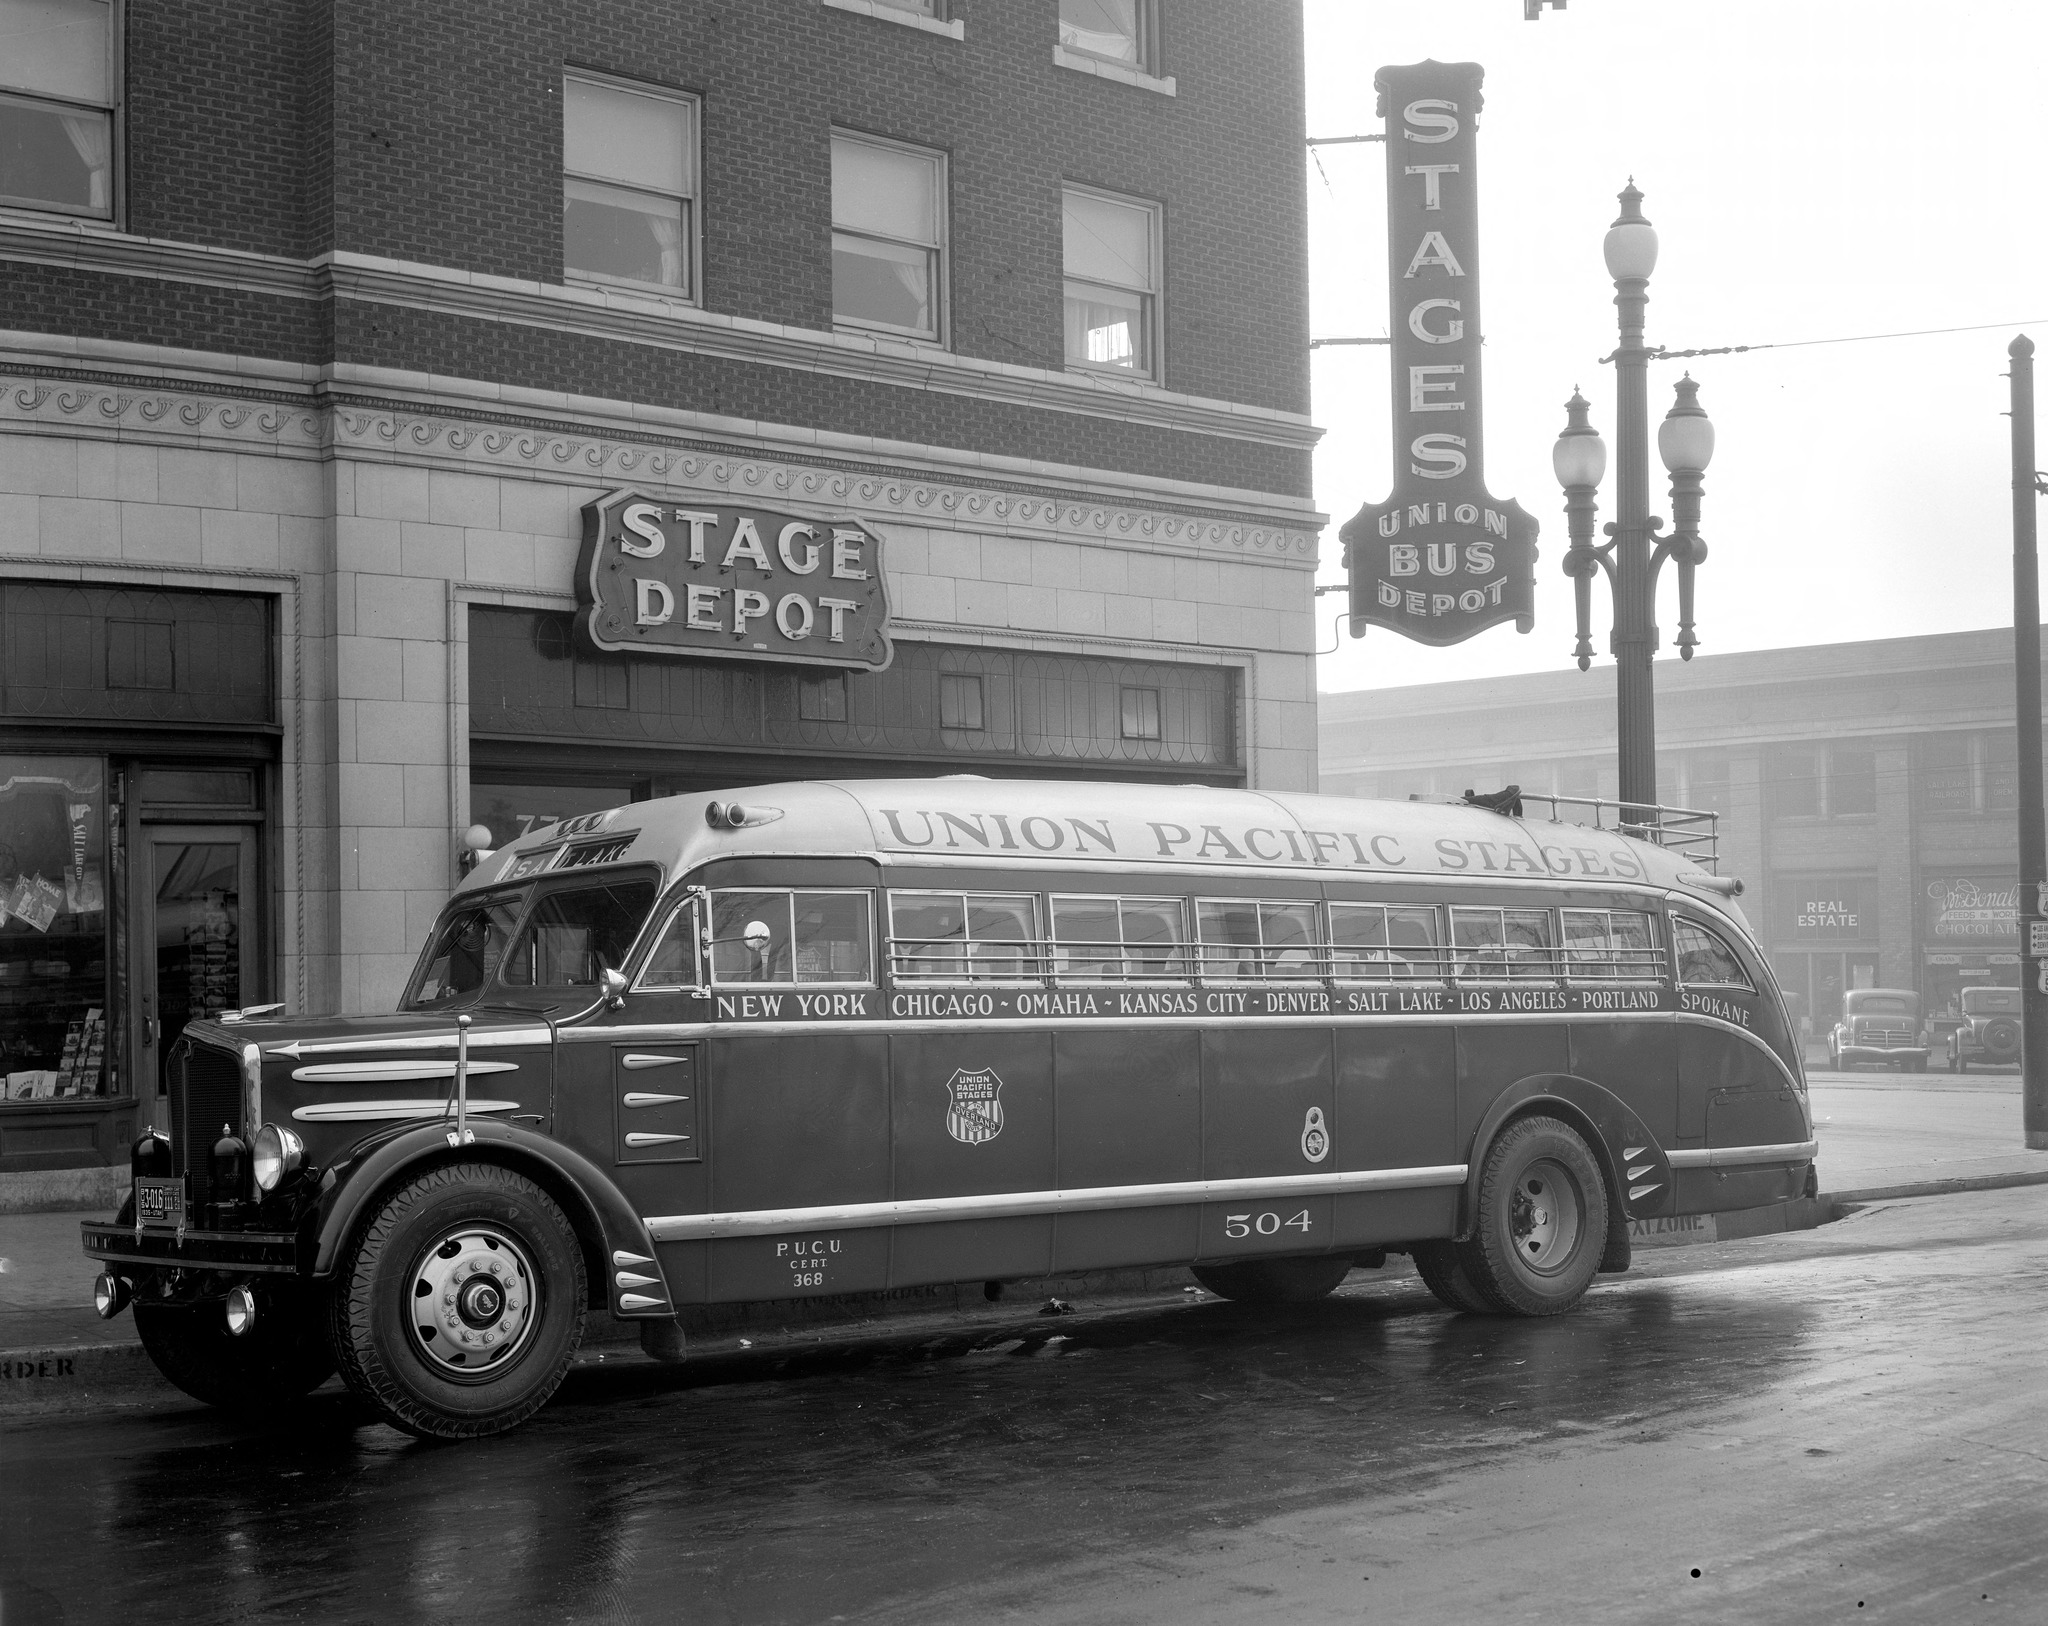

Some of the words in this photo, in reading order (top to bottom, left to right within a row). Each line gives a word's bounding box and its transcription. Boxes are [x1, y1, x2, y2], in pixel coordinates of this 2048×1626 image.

[1403, 99, 1467, 479] STAGES
[1379, 502, 1507, 539] UNION
[621, 504, 867, 580] STAGE
[1389, 542, 1495, 576] BUS
[1378, 575, 1507, 616] DEPOT
[633, 578, 857, 642] DEPOT
[73, 824, 87, 845] SALT
[879, 809, 1117, 854] UNION
[1146, 822, 1407, 867] PACIFIC
[1433, 838, 1640, 879] STAGES
[74, 848, 84, 865] LAKE
[513, 851, 577, 879] SAT
[1797, 914, 1858, 927] ESTATE
[1806, 901, 1848, 914] REAL
[1949, 911, 1976, 919] FEEDS
[717, 995, 784, 1018] NEW
[796, 994, 867, 1016] YORK
[892, 994, 993, 1016] CHICAGO
[1017, 994, 1098, 1015] OMAHA
[1120, 993, 1198, 1014] KANSAS
[1206, 993, 1247, 1013] CITY
[1267, 993, 1330, 1013] DENVER
[1348, 992, 1389, 1012] SALT
[1400, 992, 1443, 1011] LAKE
[1460, 992, 1491, 1010] LOS
[1499, 992, 1567, 1010] ANGELES
[1583, 991, 1659, 1009] PORTLAND
[1681, 993, 1750, 1028] SPOKANE
[957, 1083, 992, 1091] PACIFIC
[957, 1091, 992, 1099] STAGES
[955, 1105, 996, 1130] OVERLAND
[145, 1188, 163, 1209] 3-016
[1225, 1209, 1312, 1238] 504
[793, 1272, 823, 1287] 368
